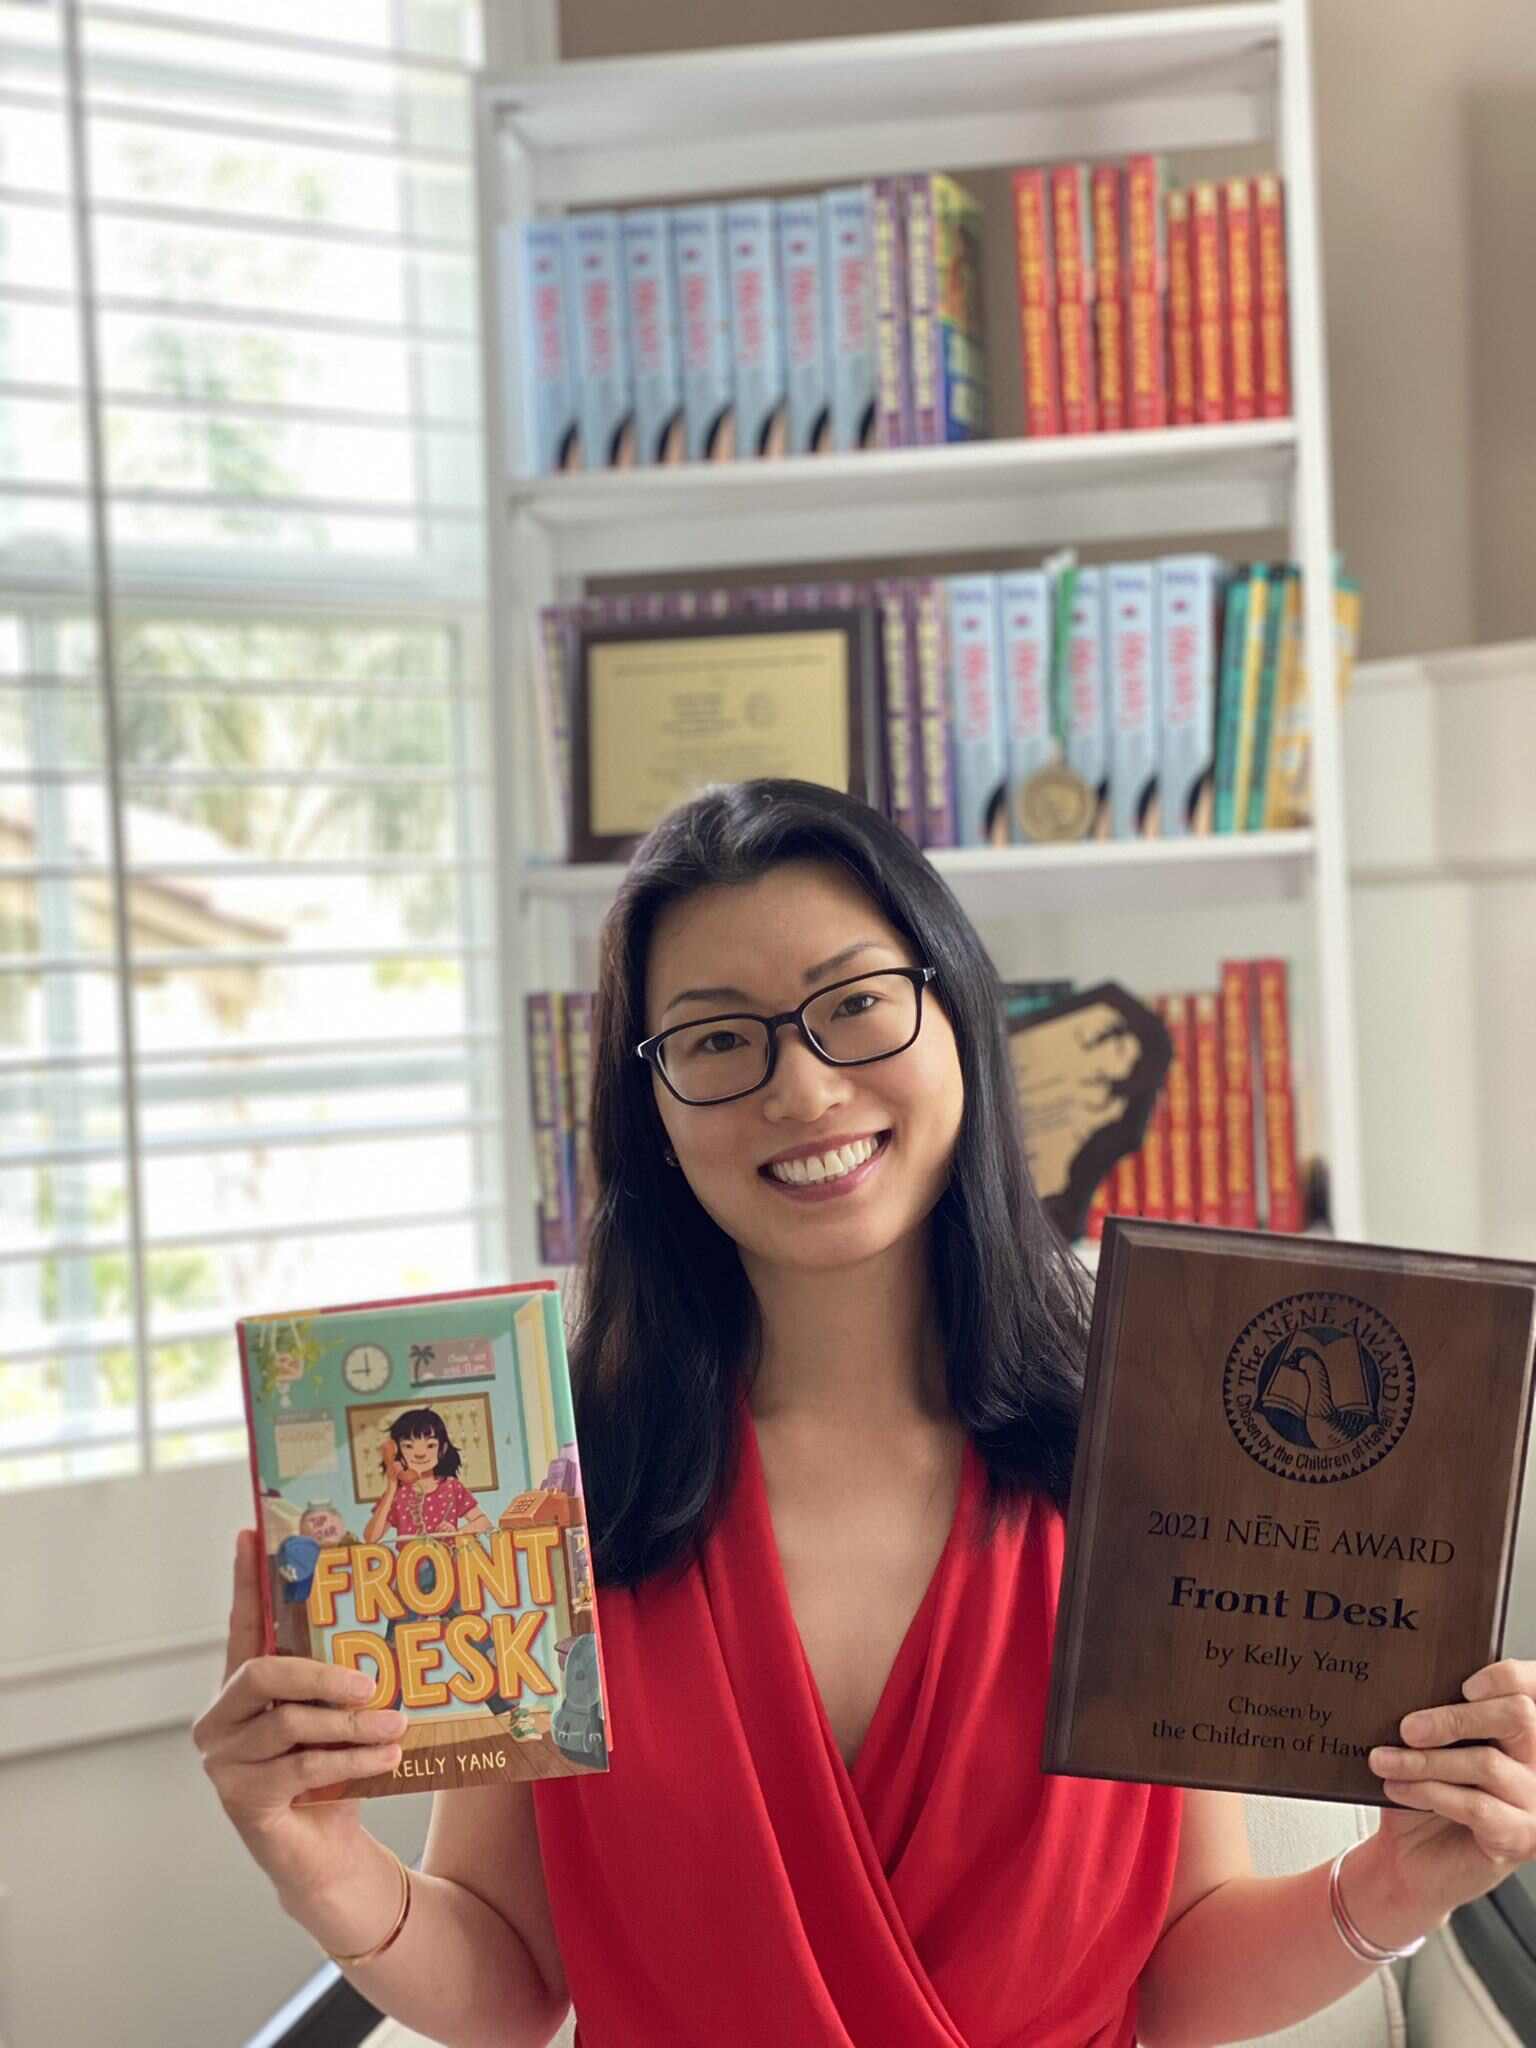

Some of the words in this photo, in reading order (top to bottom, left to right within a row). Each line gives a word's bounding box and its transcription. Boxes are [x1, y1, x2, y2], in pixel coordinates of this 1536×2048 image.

[1238, 1344, 1266, 1387] The
[1343, 1315, 1401, 1403] AWARD
[1272, 1445, 1294, 1466] the
[1295, 1453, 1352, 1471] Children
[1350, 1443, 1367, 1464] of
[1147, 1510, 1210, 1540] 2021
[1224, 1514, 1321, 1552] NĒNĒ
[1330, 1529, 1456, 1566] AWARD
[307, 1525, 560, 1628] FRONT
[1167, 1575, 1290, 1619] Front
[1302, 1588, 1420, 1632] Desk
[331, 1610, 558, 1710] DESK
[1205, 1639, 1235, 1669] by
[1243, 1644, 1303, 1675] Kelly
[1312, 1650, 1372, 1682] Yang
[1152, 1719, 1186, 1740] the
[1192, 1722, 1286, 1750] Children
[1292, 1734, 1315, 1753] of
[1227, 1695, 1303, 1720] Chosen
[1308, 1704, 1333, 1729] by
[456, 1750, 507, 1773] YANG
